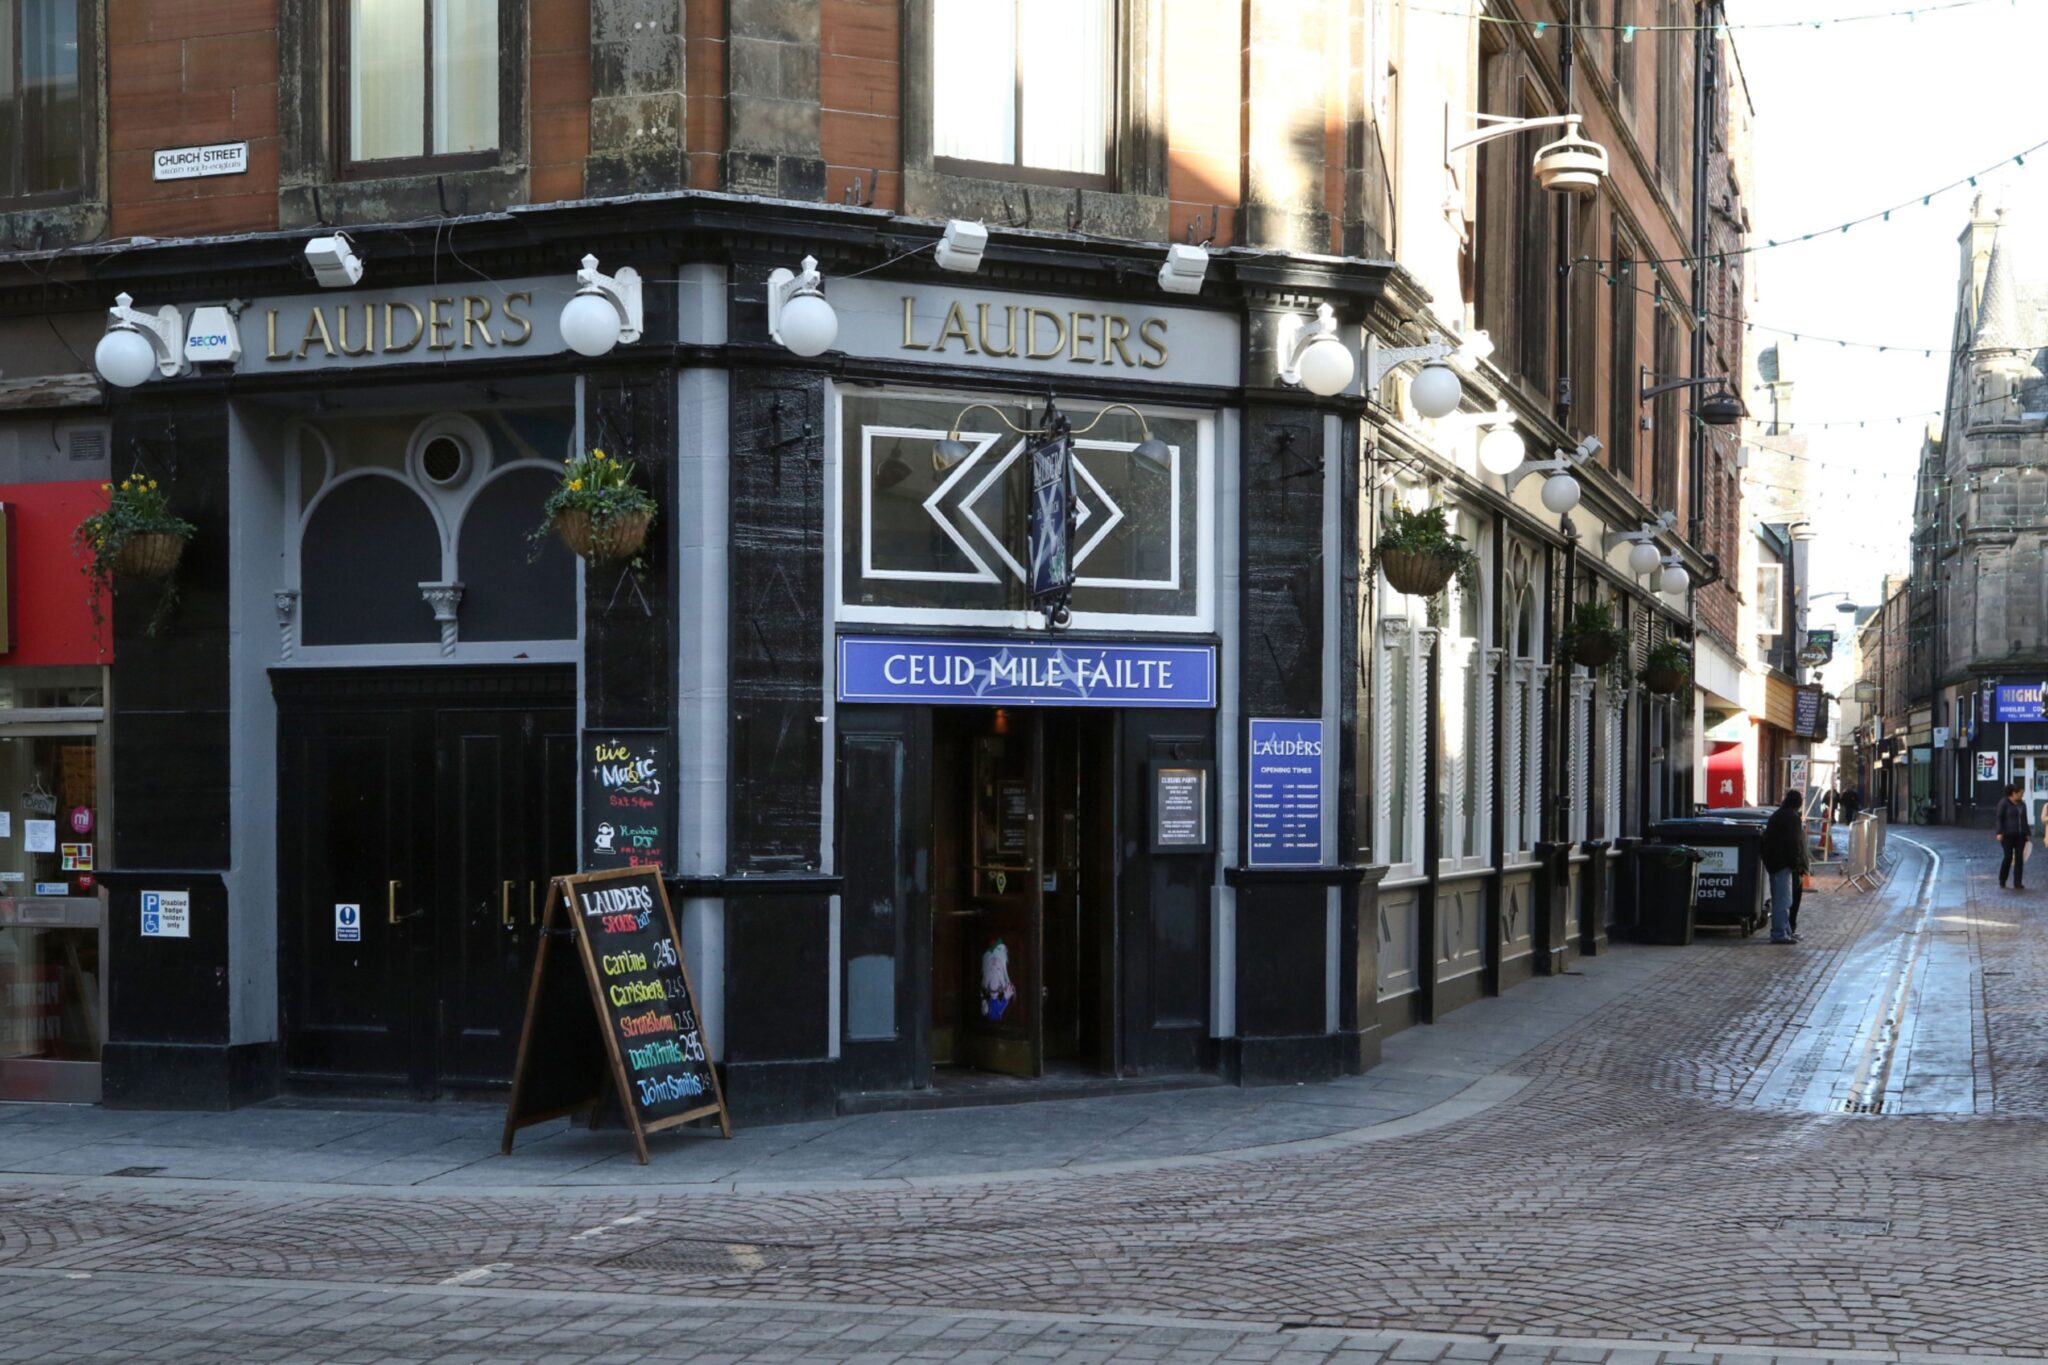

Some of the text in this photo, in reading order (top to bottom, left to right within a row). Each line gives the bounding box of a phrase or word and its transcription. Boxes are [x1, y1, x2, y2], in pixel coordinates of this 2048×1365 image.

[158, 147, 242, 166] CHURCH STREET
[265, 291, 533, 362] LAUDERS
[901, 296, 1169, 368] LAUDERS
[190, 334, 228, 347] SECOM
[1802, 652, 1828, 660] PIZZA
[884, 651, 1174, 690] CEUD MILE FÁILTE
[1253, 740, 1322, 756] LAUDERS
[602, 756, 657, 787] Music
[25, 799, 50, 810] OPEN
[620, 825, 658, 837] Resident
[633, 836, 653, 847] DJ
[1699, 876, 1733, 887] neral
[581, 885, 652, 915] LAUDERS
[1698, 889, 1726, 898] aste
[602, 911, 637, 934] SPORTS
[603, 950, 647, 976] Carling
[610, 979, 664, 1007] Carlsberg
